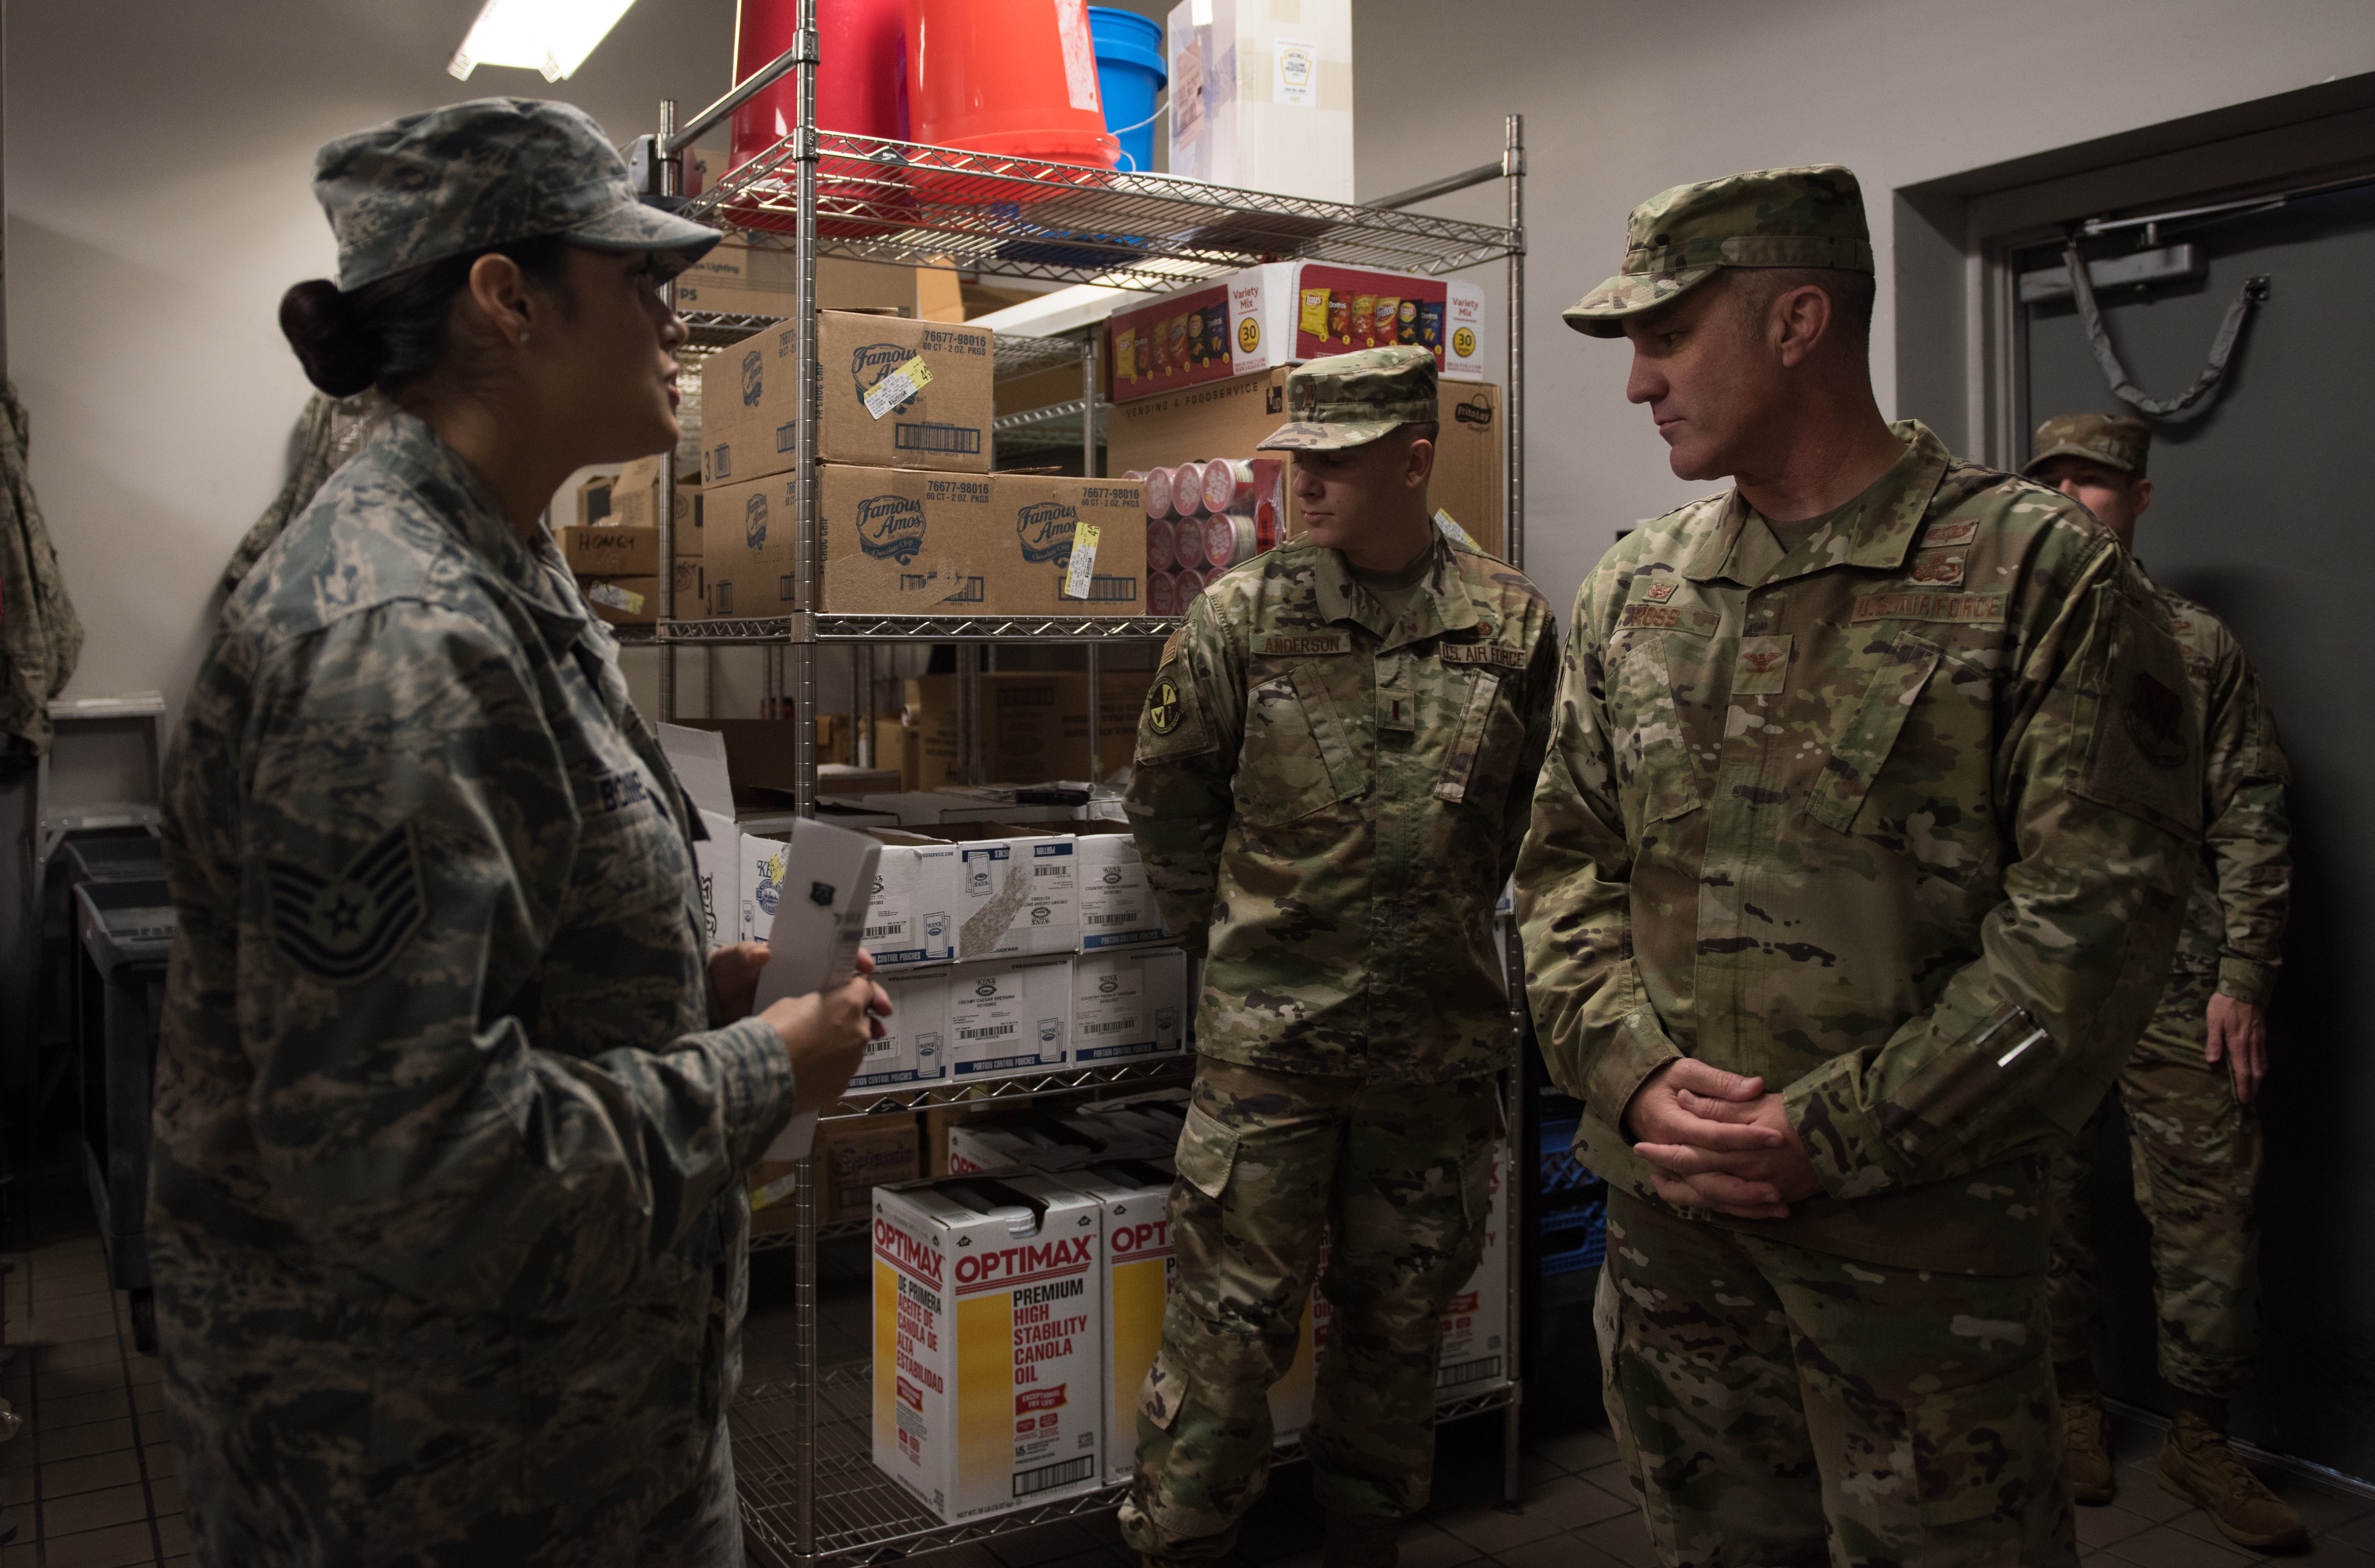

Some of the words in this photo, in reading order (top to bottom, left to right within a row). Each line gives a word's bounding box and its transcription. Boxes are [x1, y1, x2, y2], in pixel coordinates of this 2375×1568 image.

[1233, 287, 1258, 300] Variety
[1241, 299, 1253, 309] Mix
[1452, 297, 1478, 310] Variety
[1459, 308, 1471, 316] Mix
[925, 331, 986, 347] 76677-98016
[1243, 325, 1256, 340] 30
[1459, 334, 1471, 346] 30
[933, 343, 942, 351] CT
[954, 345, 966, 353] OZ.
[968, 347, 986, 356] PKGS
[852, 347, 917, 373] Famous
[921, 370, 928, 381] 4
[1127, 401, 1168, 418] VENDING
[1174, 399, 1179, 407] &
[1186, 382, 1258, 405] FOODSERVICE
[1272, 397, 1282, 412] up
[705, 450, 710, 482] 3
[928, 481, 988, 495] 76677-98016
[1083, 487, 1139, 499] 76677-98016
[937, 493, 945, 501] CT
[951, 493, 955, 502] 2
[957, 494, 969, 502] OZ.
[971, 494, 988, 503] PKGS
[856, 499, 921, 526] Famous
[1017, 505, 1076, 533] Famous
[873, 515, 921, 538] Amos
[1033, 521, 1076, 543] Amos
[872, 545, 898, 556] Chocolate
[899, 540, 913, 549] Chip
[1032, 549, 1057, 560] Chocolate
[1057, 543, 1071, 552] Chip
[707, 584, 711, 616] 3
[1859, 597, 1891, 617] U.S.
[1897, 596, 1930, 616] AIR
[1936, 597, 2000, 618] FORCE
[1631, 605, 1679, 628] ROSS
[1265, 637, 1339, 653] ANDERSON
[1442, 645, 1461, 662] U.S.
[1465, 646, 1487, 663] AIR
[1491, 648, 1525, 667] FORCE
[1036, 846, 1055, 855] PORTION
[1101, 935, 1119, 945] PORTION
[877, 952, 899, 964] CONTROL
[900, 951, 921, 961] POUCHES
[1012, 960, 1067, 969] WWW.KENSFOODSERVICE.COM
[888, 973, 947, 982] WWW.KENSFOODSERVICE.COM
[1093, 1049, 1112, 1058] PORTION
[973, 1062, 992, 1071] PORTION
[993, 1059, 1015, 1069] CONTROL
[1016, 1057, 1035, 1066] POUCHES
[868, 1074, 890, 1084] CONTROL
[891, 1072, 912, 1082] POUCHES
[875, 1218, 943, 1283] OPTIMAX
[955, 1235, 1092, 1283] OPTIMAX
[898, 1274, 906, 1294] DE
[909, 1280, 941, 1316] PRIMERA
[1014, 1278, 1083, 1307] PREMIUM
[898, 1293, 921, 1322] ACEITE
[924, 1309, 933, 1330] DE
[1014, 1303, 1049, 1327] HIGH
[898, 1312, 925, 1344] CANOLA
[928, 1331, 937, 1353] DE
[1014, 1314, 1088, 1346] STABILITY
[898, 1331, 913, 1356] ALTA
[1014, 1338, 1072, 1365] CANOLA
[897, 1350, 943, 1394] ESTABILIDAD
[1015, 1365, 1038, 1385] OIL
